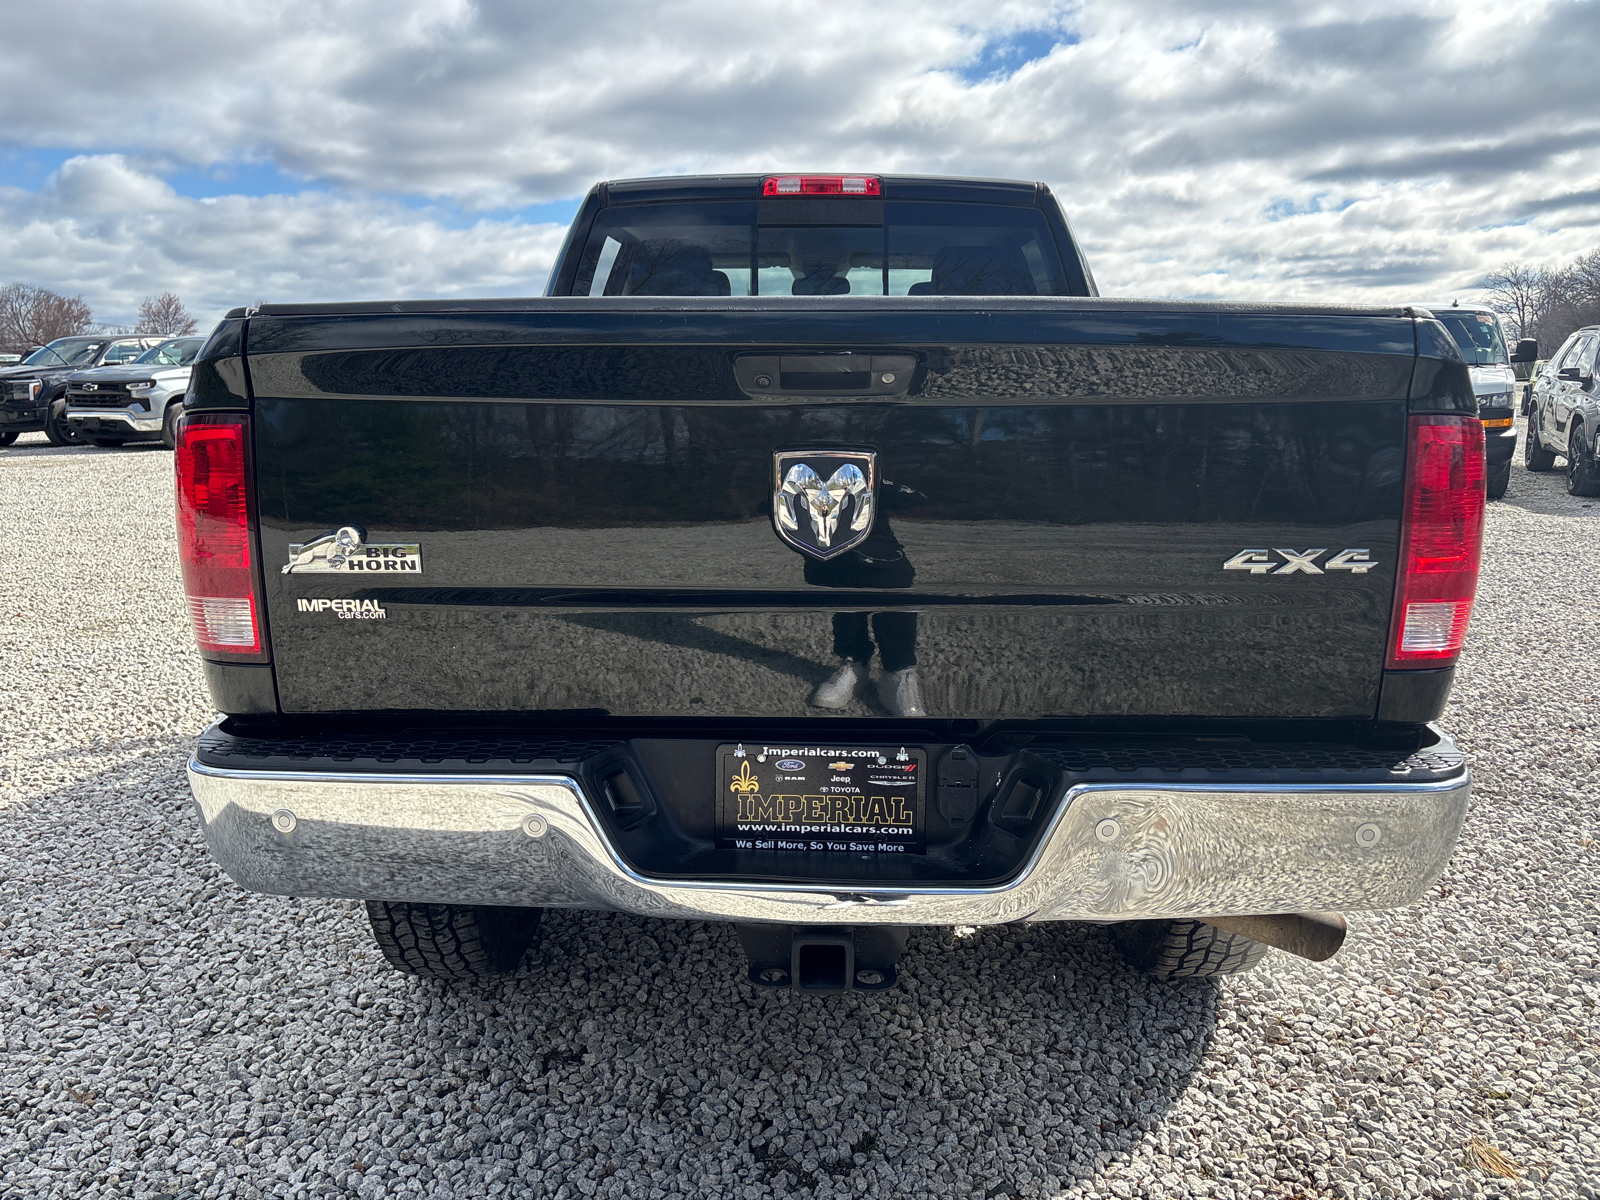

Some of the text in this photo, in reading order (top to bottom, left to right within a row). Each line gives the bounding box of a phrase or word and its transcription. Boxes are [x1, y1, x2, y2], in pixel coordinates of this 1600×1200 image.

[366, 547, 407, 558] BIG
[348, 560, 417, 571] HORN
[297, 598, 386, 612] IMPERIAL
[338, 610, 386, 619] cars.com
[763, 746, 880, 758] Imperialcars.com
[830, 774, 851, 784] Jeep
[830, 786, 861, 794] TOYOTA
[737, 794, 913, 825] IMPERIAL
[737, 822, 913, 835] www.imperialcars.com
[735, 840, 905, 852] We Sell More, So You Save More
